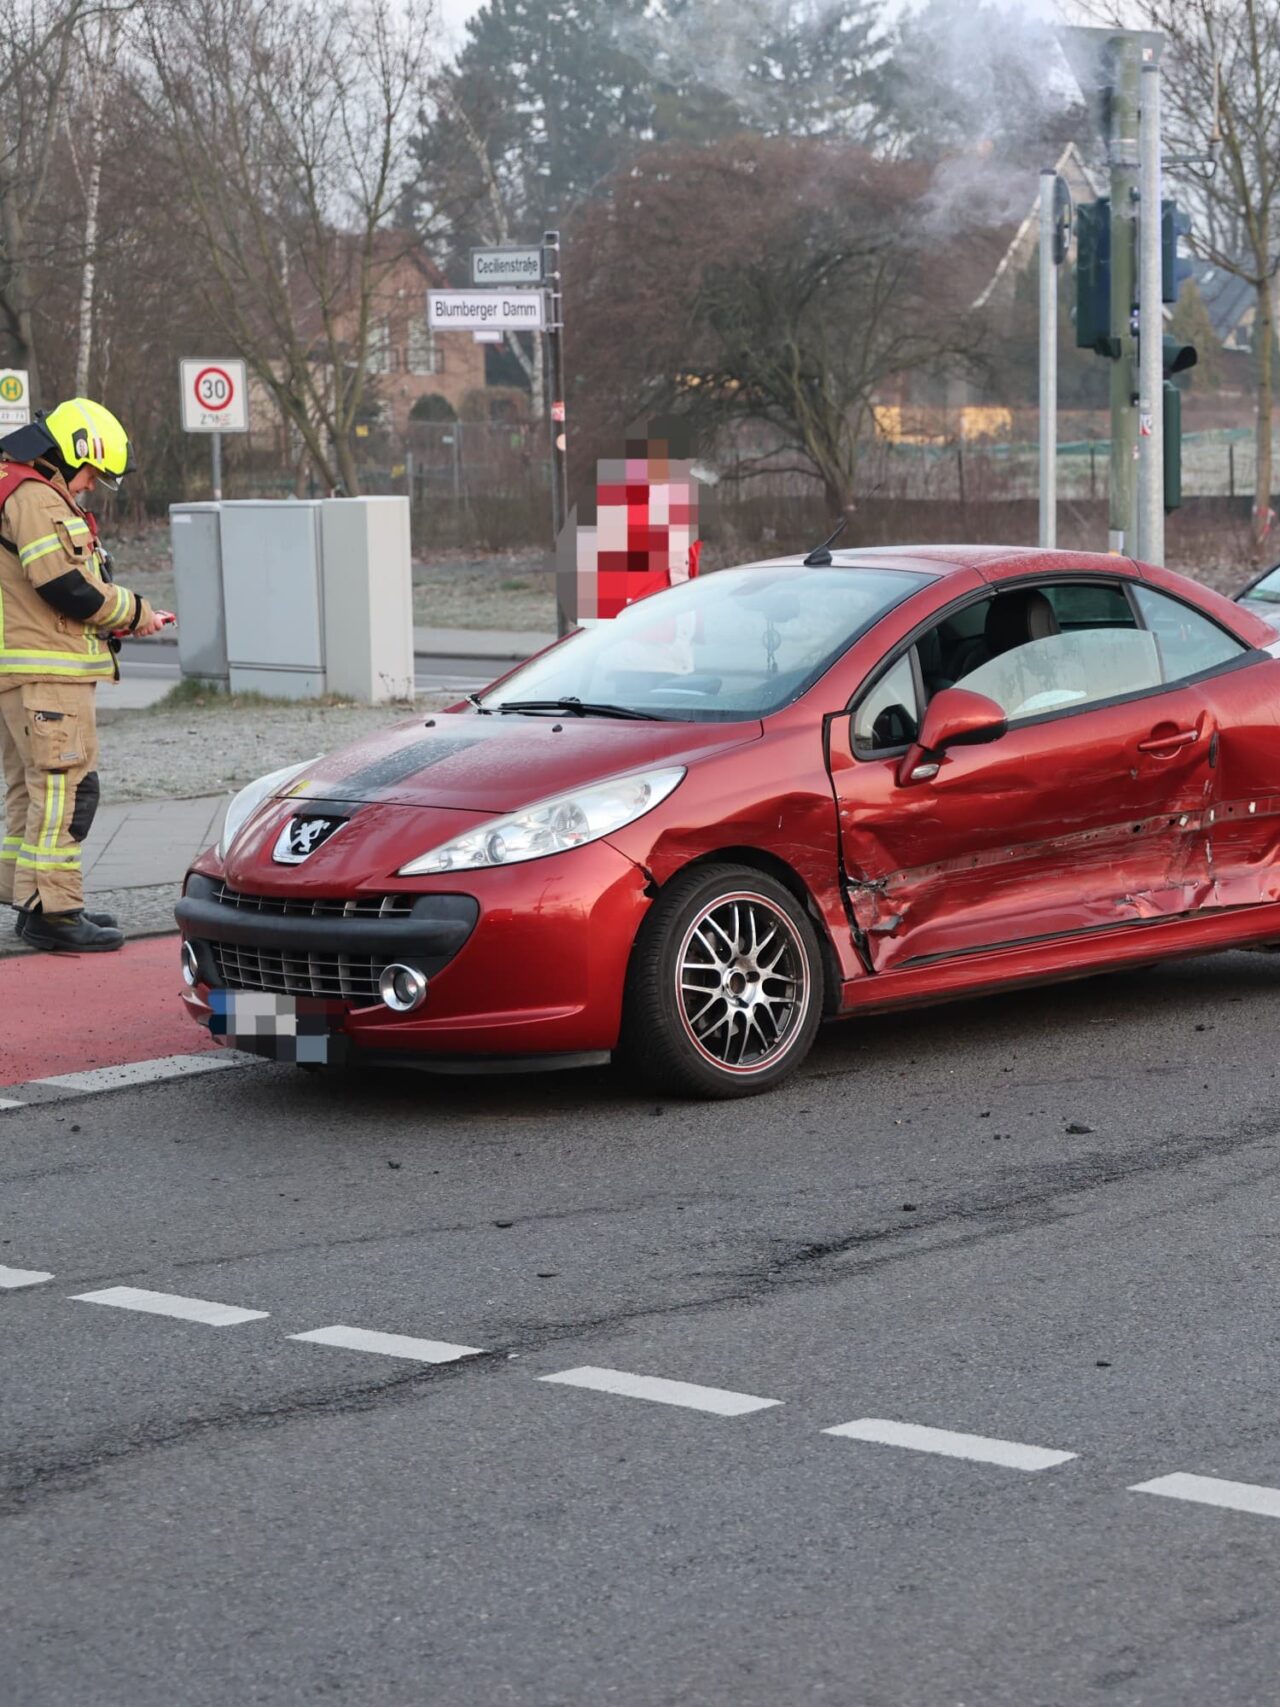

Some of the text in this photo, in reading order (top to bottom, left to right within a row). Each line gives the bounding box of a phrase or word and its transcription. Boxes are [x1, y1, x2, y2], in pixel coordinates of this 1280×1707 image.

[476, 256, 538, 276] Cecilienstraße
[435, 301, 536, 321] Blumberger Damm
[202, 379, 226, 399] 30
